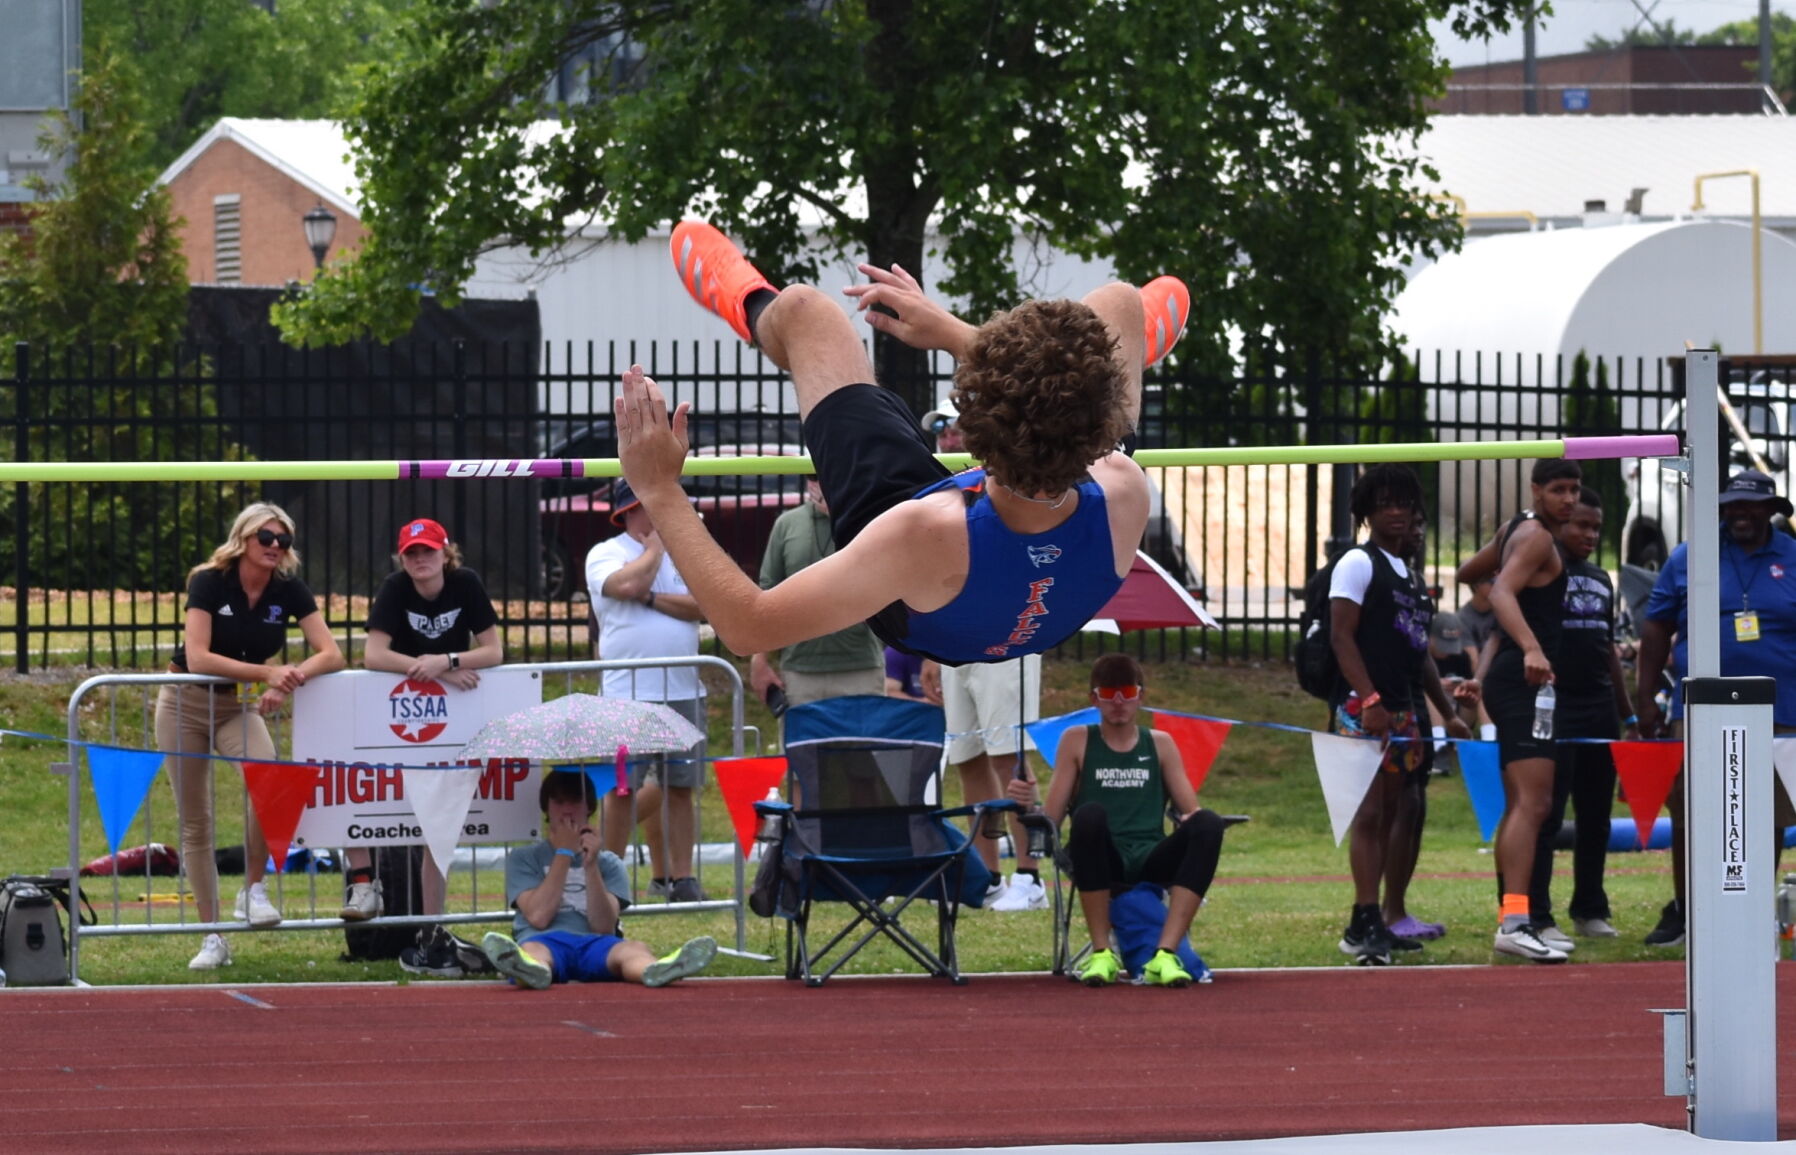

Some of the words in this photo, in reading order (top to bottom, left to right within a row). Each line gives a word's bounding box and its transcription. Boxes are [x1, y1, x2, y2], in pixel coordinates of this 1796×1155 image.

[445, 459, 536, 477] GILL
[410, 523, 425, 537] P
[268, 605, 283, 621] P
[418, 615, 449, 630] PAGE
[389, 696, 448, 719] TSSAA
[1729, 729, 1739, 790] FIRST
[1095, 768, 1150, 780] NORTHVIEW
[306, 758, 404, 809] HIGH
[1101, 780, 1146, 788] ACADEMY
[347, 824, 423, 839] Coache
[1729, 803, 1739, 863] PLACE
